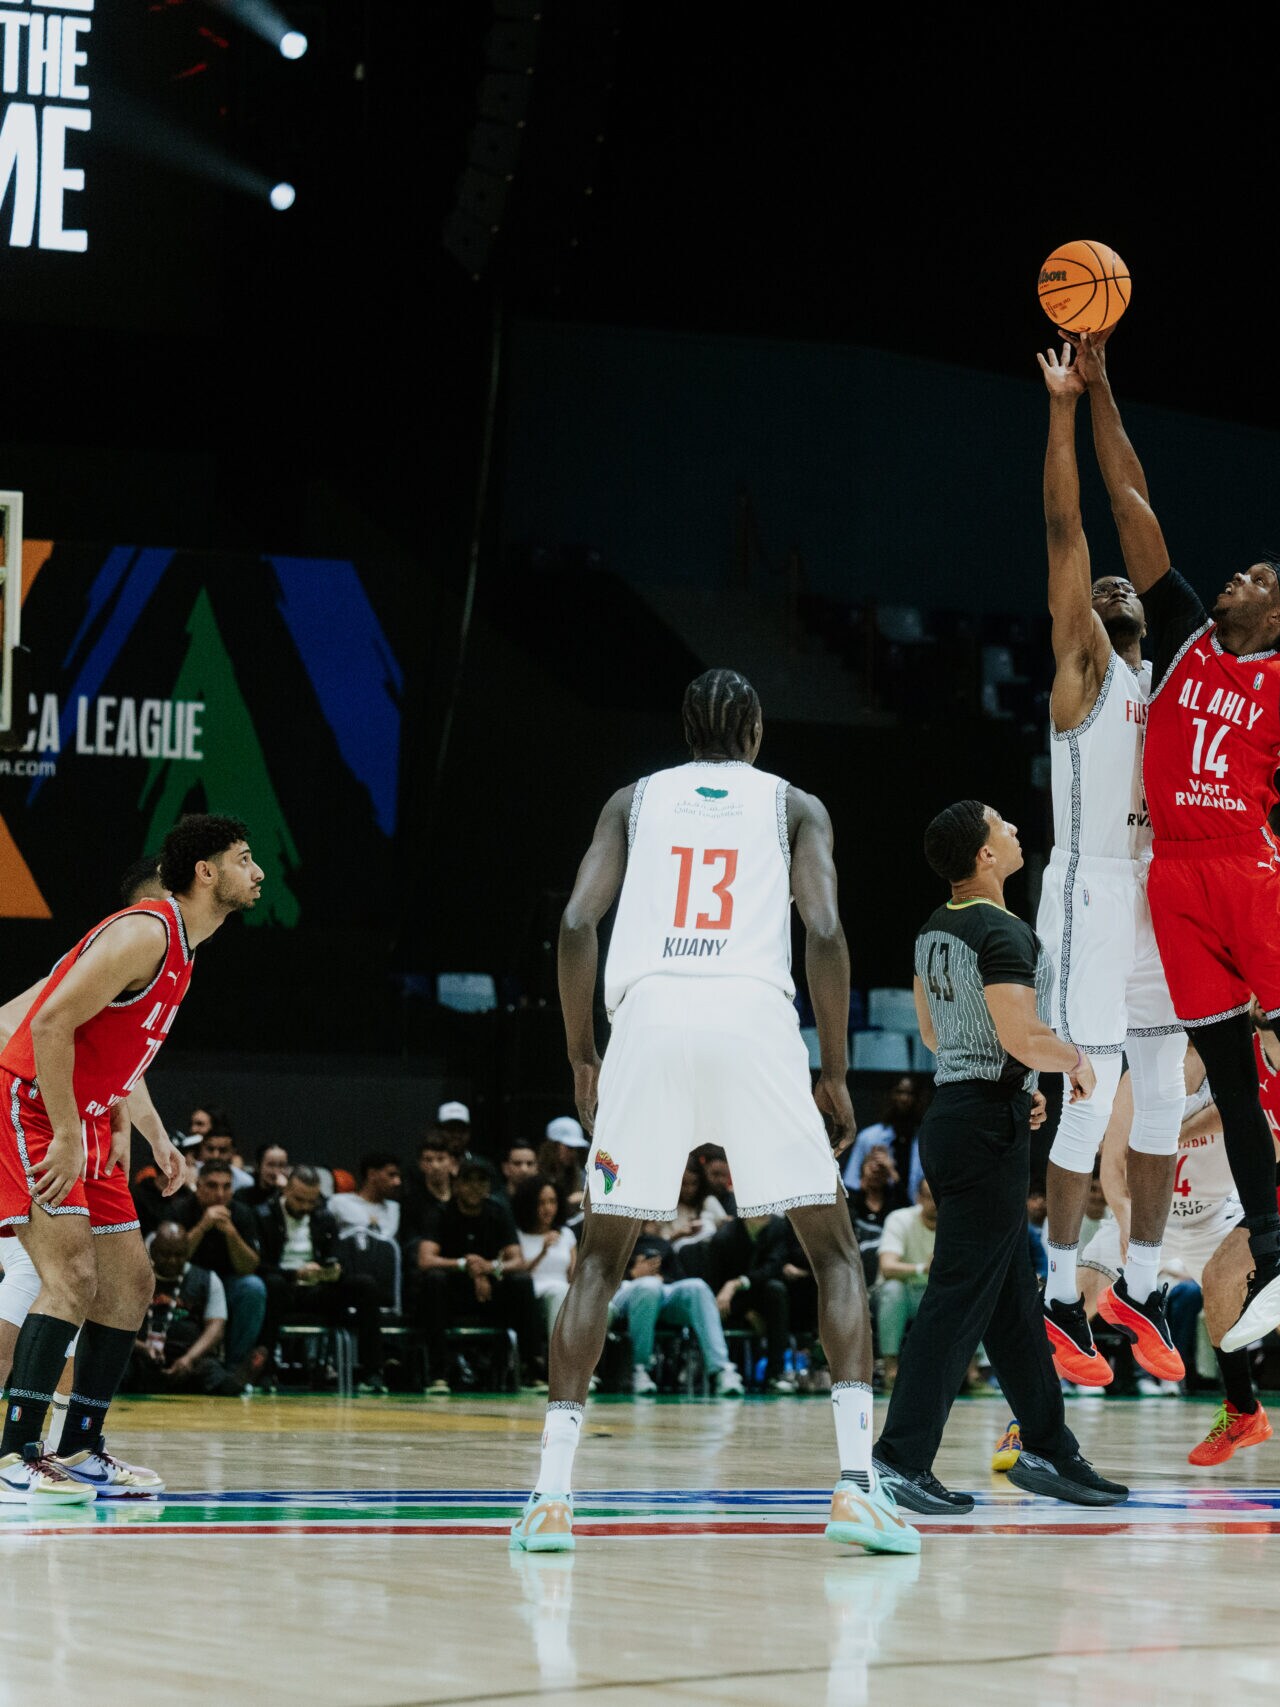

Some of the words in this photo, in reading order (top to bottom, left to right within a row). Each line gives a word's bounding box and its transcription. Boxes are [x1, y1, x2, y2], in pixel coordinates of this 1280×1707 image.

[0, 9, 92, 101] THE
[76, 695, 205, 760] LEAGUE
[1177, 678, 1203, 712] AL
[1206, 687, 1264, 731] AHLY
[1191, 717, 1232, 780] 14
[1175, 791, 1247, 811] RWANDA
[1188, 778, 1230, 798] VISIT
[671, 845, 739, 931] 13
[662, 936, 728, 959] KUANY
